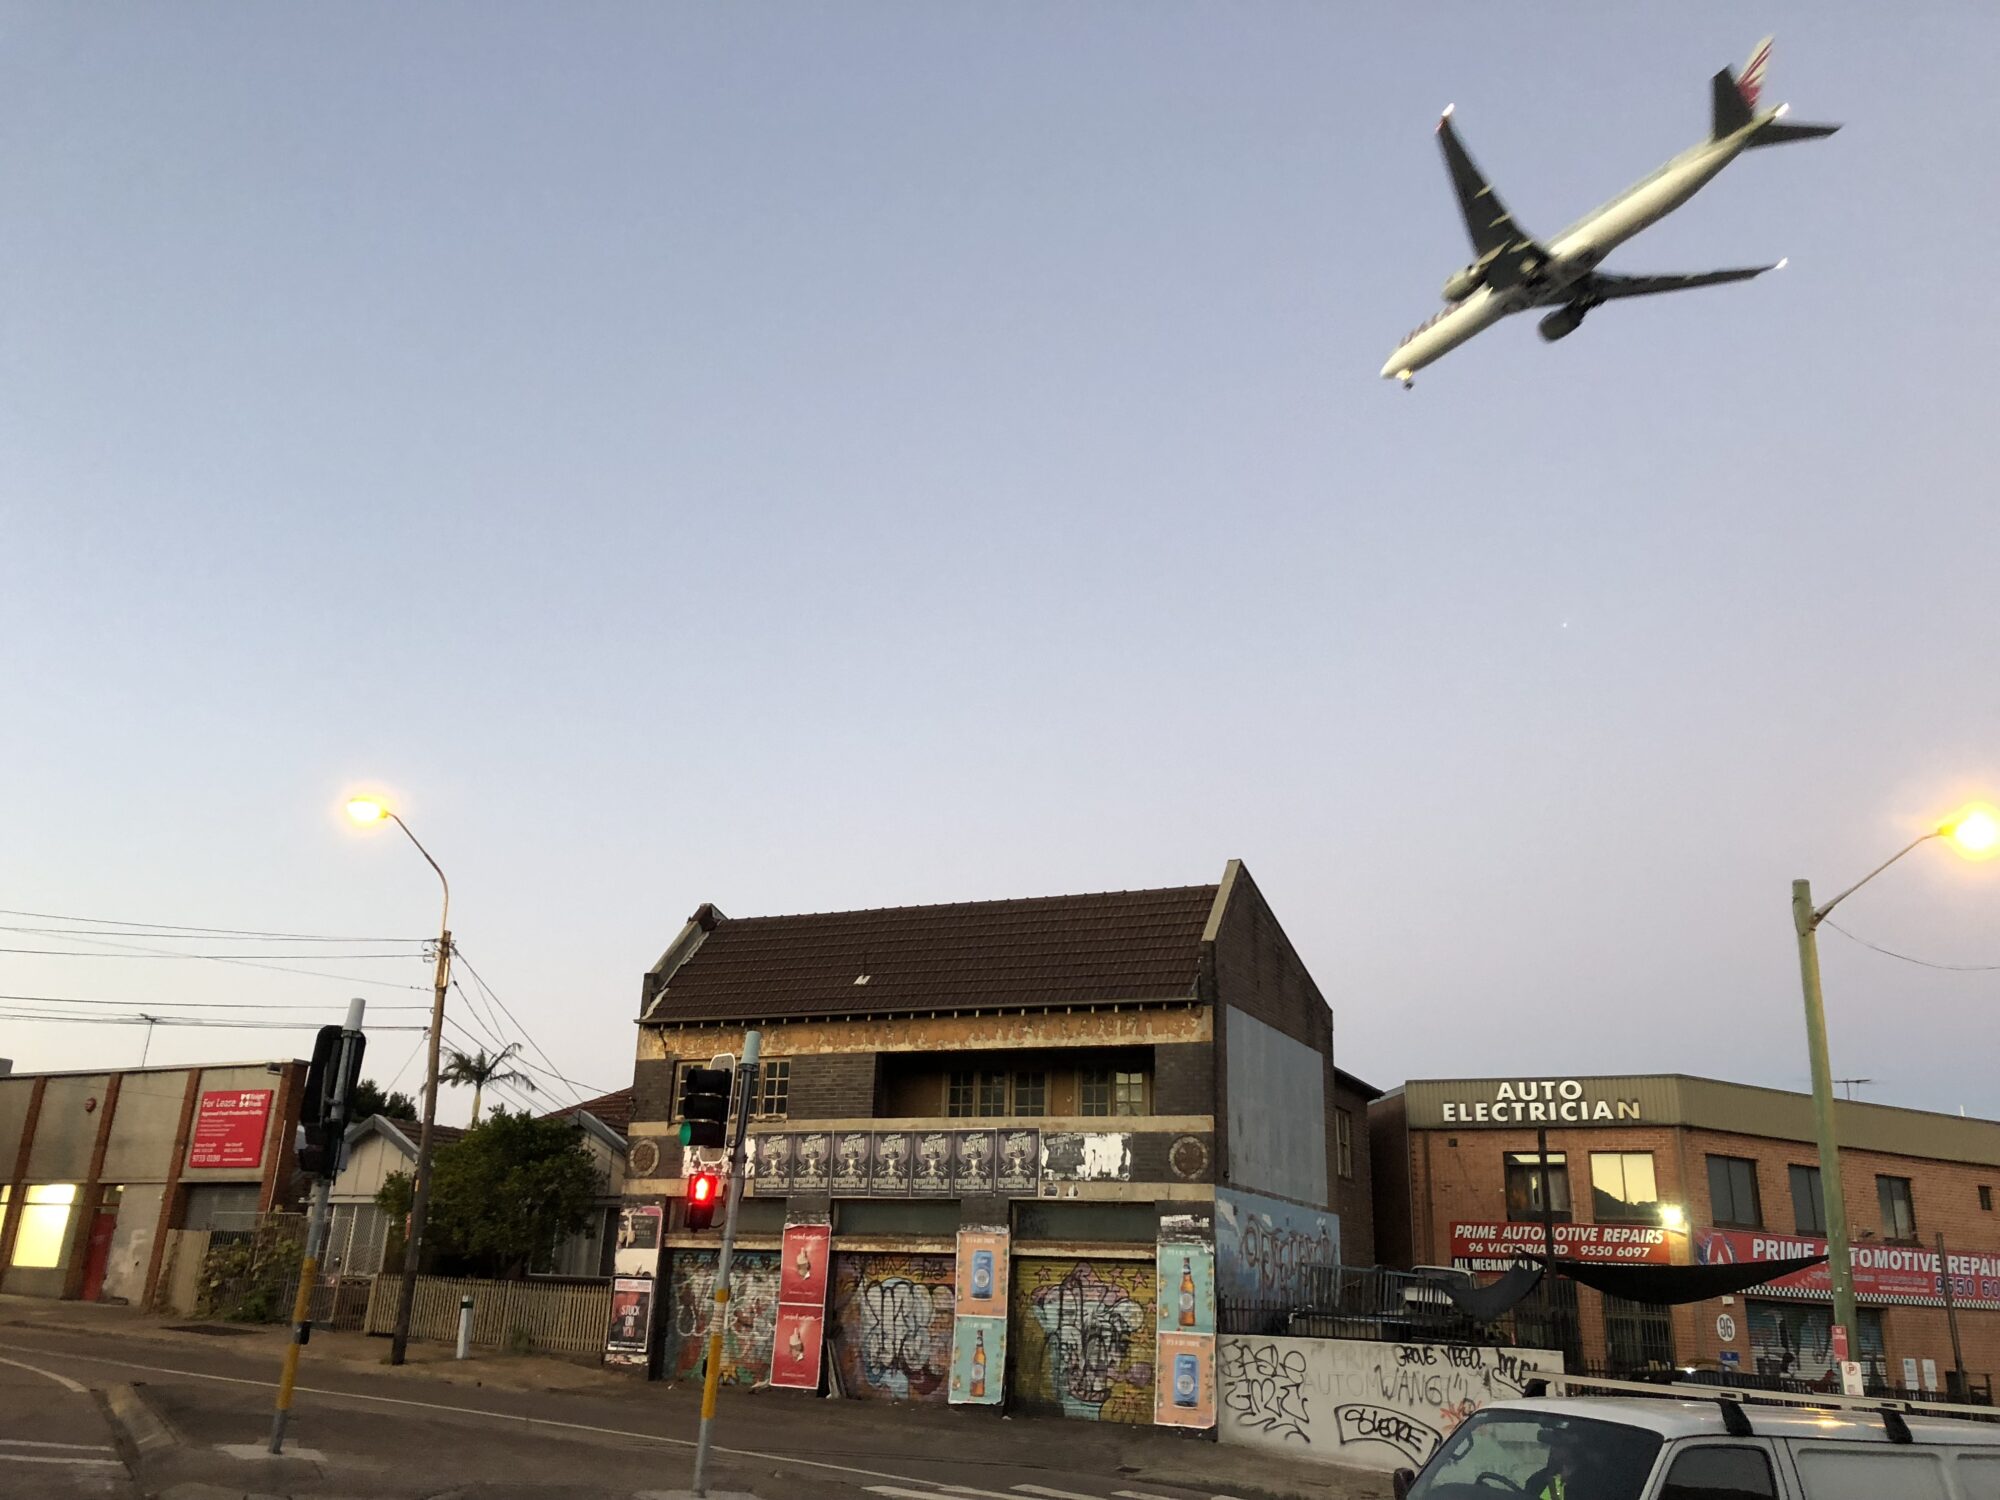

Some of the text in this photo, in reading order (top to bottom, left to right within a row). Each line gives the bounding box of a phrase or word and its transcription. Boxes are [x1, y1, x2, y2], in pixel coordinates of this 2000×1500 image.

[1496, 1080, 1583, 1100] AUTO
[202, 1098, 237, 1108] For Lease
[1442, 1101, 1641, 1122] ELECTRICIAN
[1455, 1225, 1664, 1245] PRIME AUTOOTIVE REPAIRS
[1468, 1242, 1651, 1258] 96 VICTORIA RD 9550 6097
[1752, 1238, 1815, 1261] PRIME
[1454, 1258, 1470, 1271] ALL
[620, 1304, 640, 1316] STUCK
[624, 1316, 635, 1327] ON
[1719, 1318, 1733, 1338] 96
[622, 1327, 635, 1338] YOU
